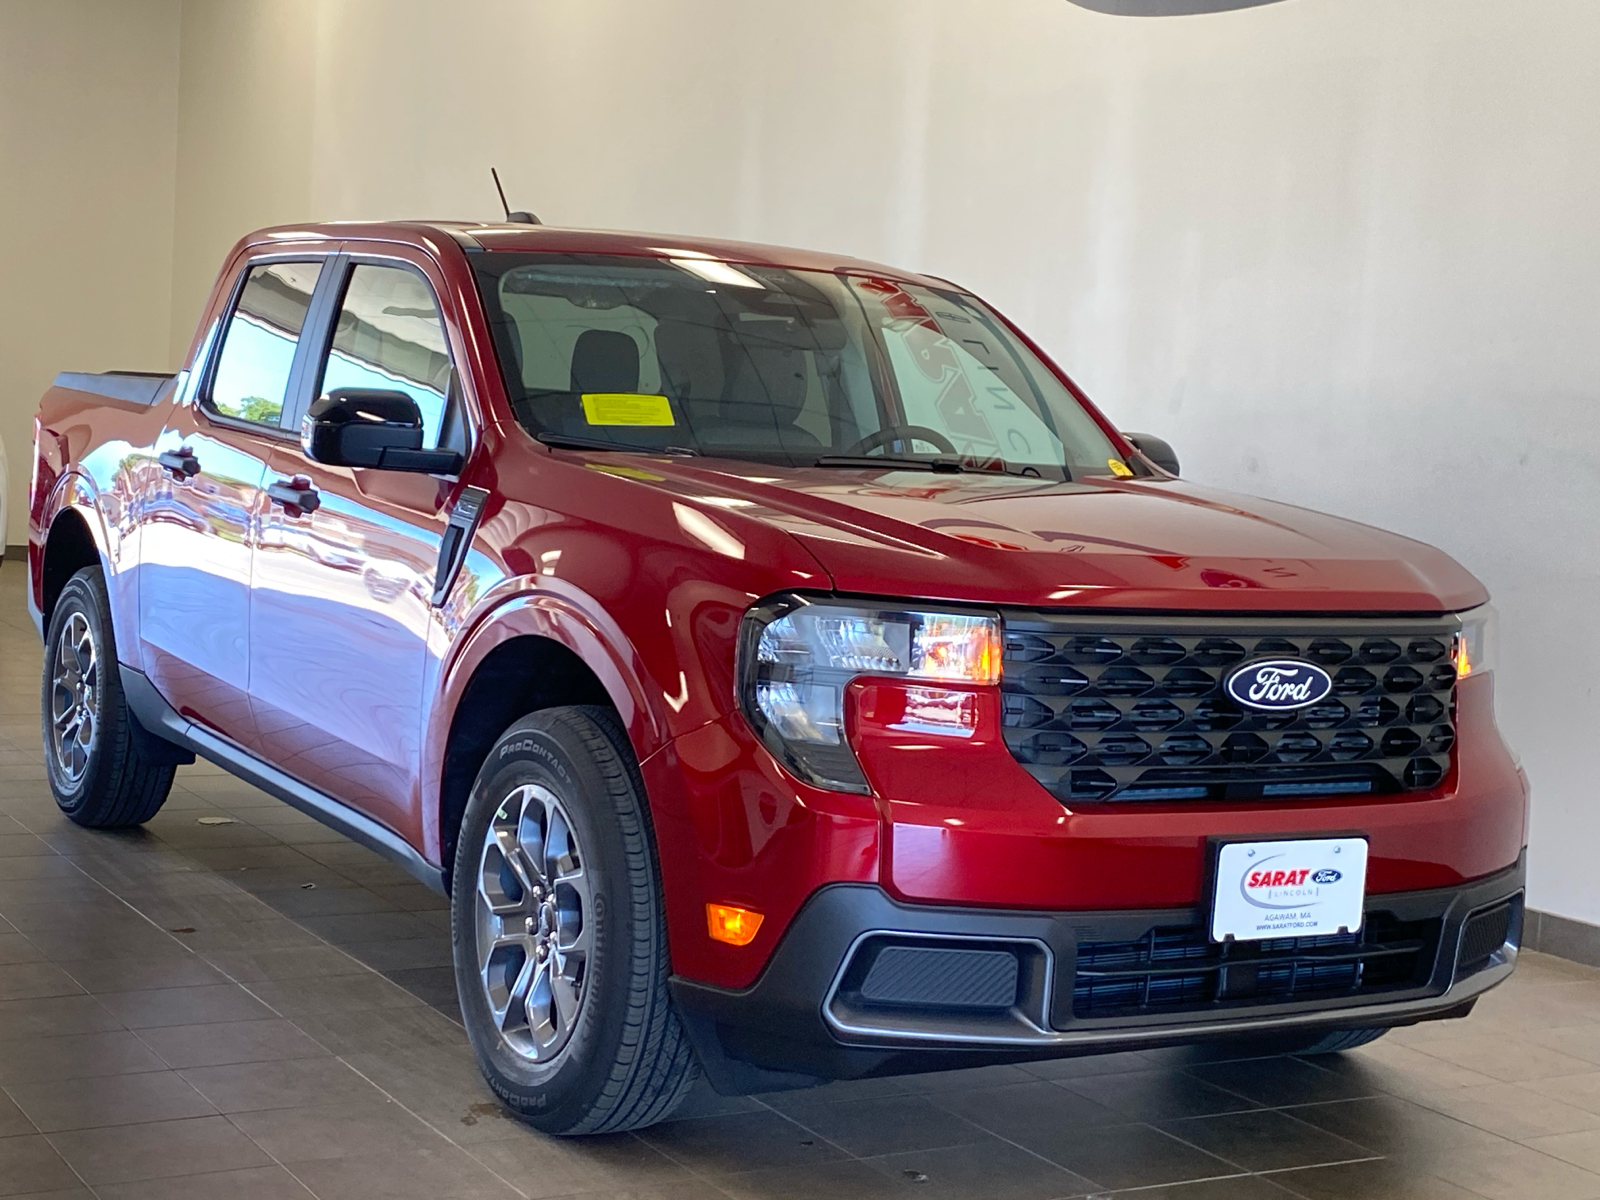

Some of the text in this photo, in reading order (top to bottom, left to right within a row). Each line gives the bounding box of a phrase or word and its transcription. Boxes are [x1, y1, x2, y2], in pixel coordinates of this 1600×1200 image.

[1248, 667, 1314, 701] Ford
[1248, 869, 1339, 888] SARAT Ford
[1274, 889, 1313, 898] LINCOLN
[1264, 912, 1311, 921] AGAWAM, MA
[1256, 921, 1318, 930] WWW.SARATFORD.COM
